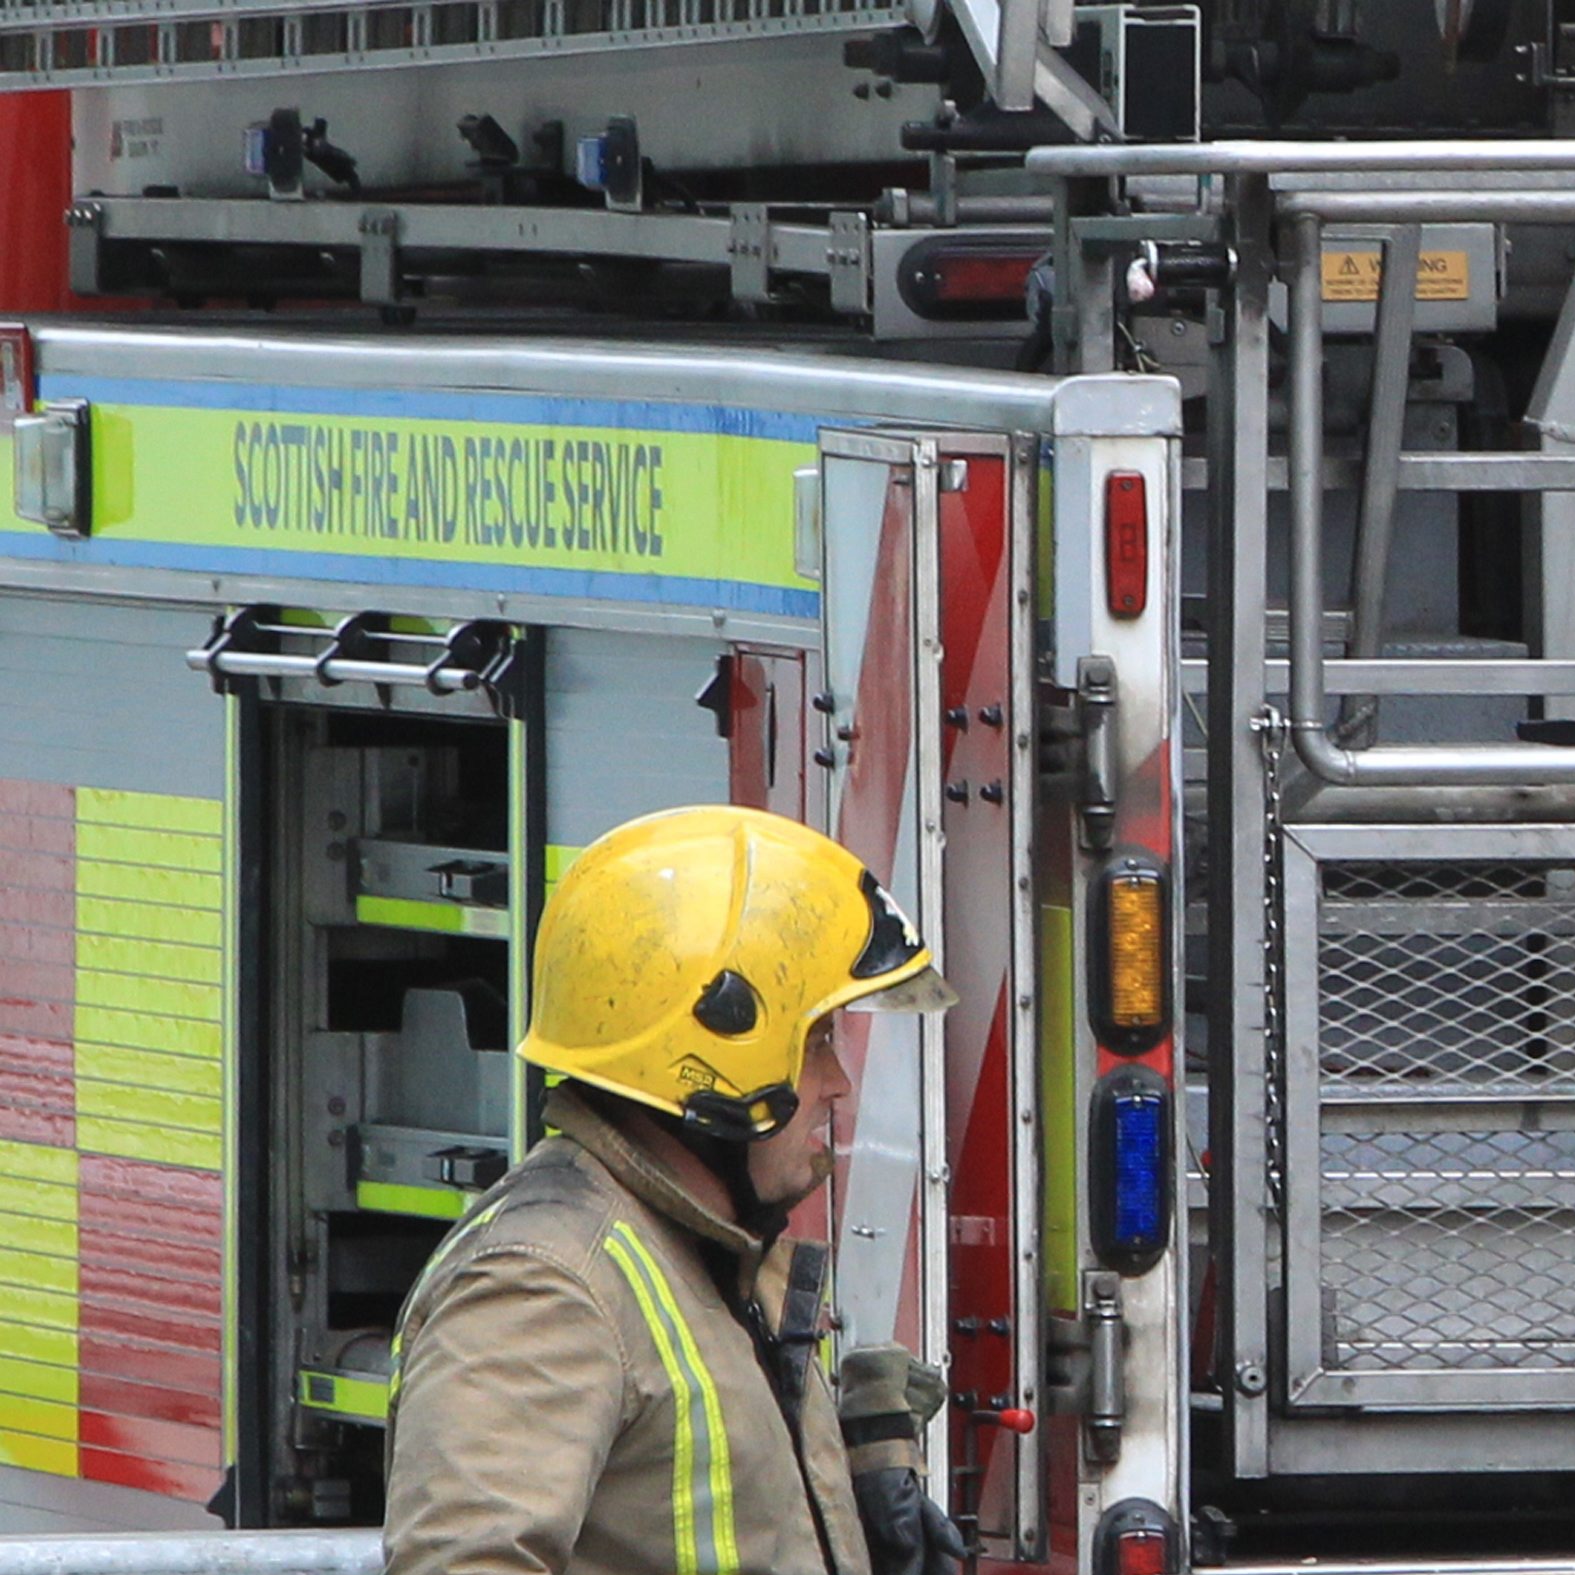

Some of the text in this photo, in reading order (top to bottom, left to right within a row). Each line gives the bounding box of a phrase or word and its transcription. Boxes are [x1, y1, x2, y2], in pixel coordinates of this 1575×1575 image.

[234, 421, 662, 557] SCOTTISH FIRE AND RESCUE SERVICE
